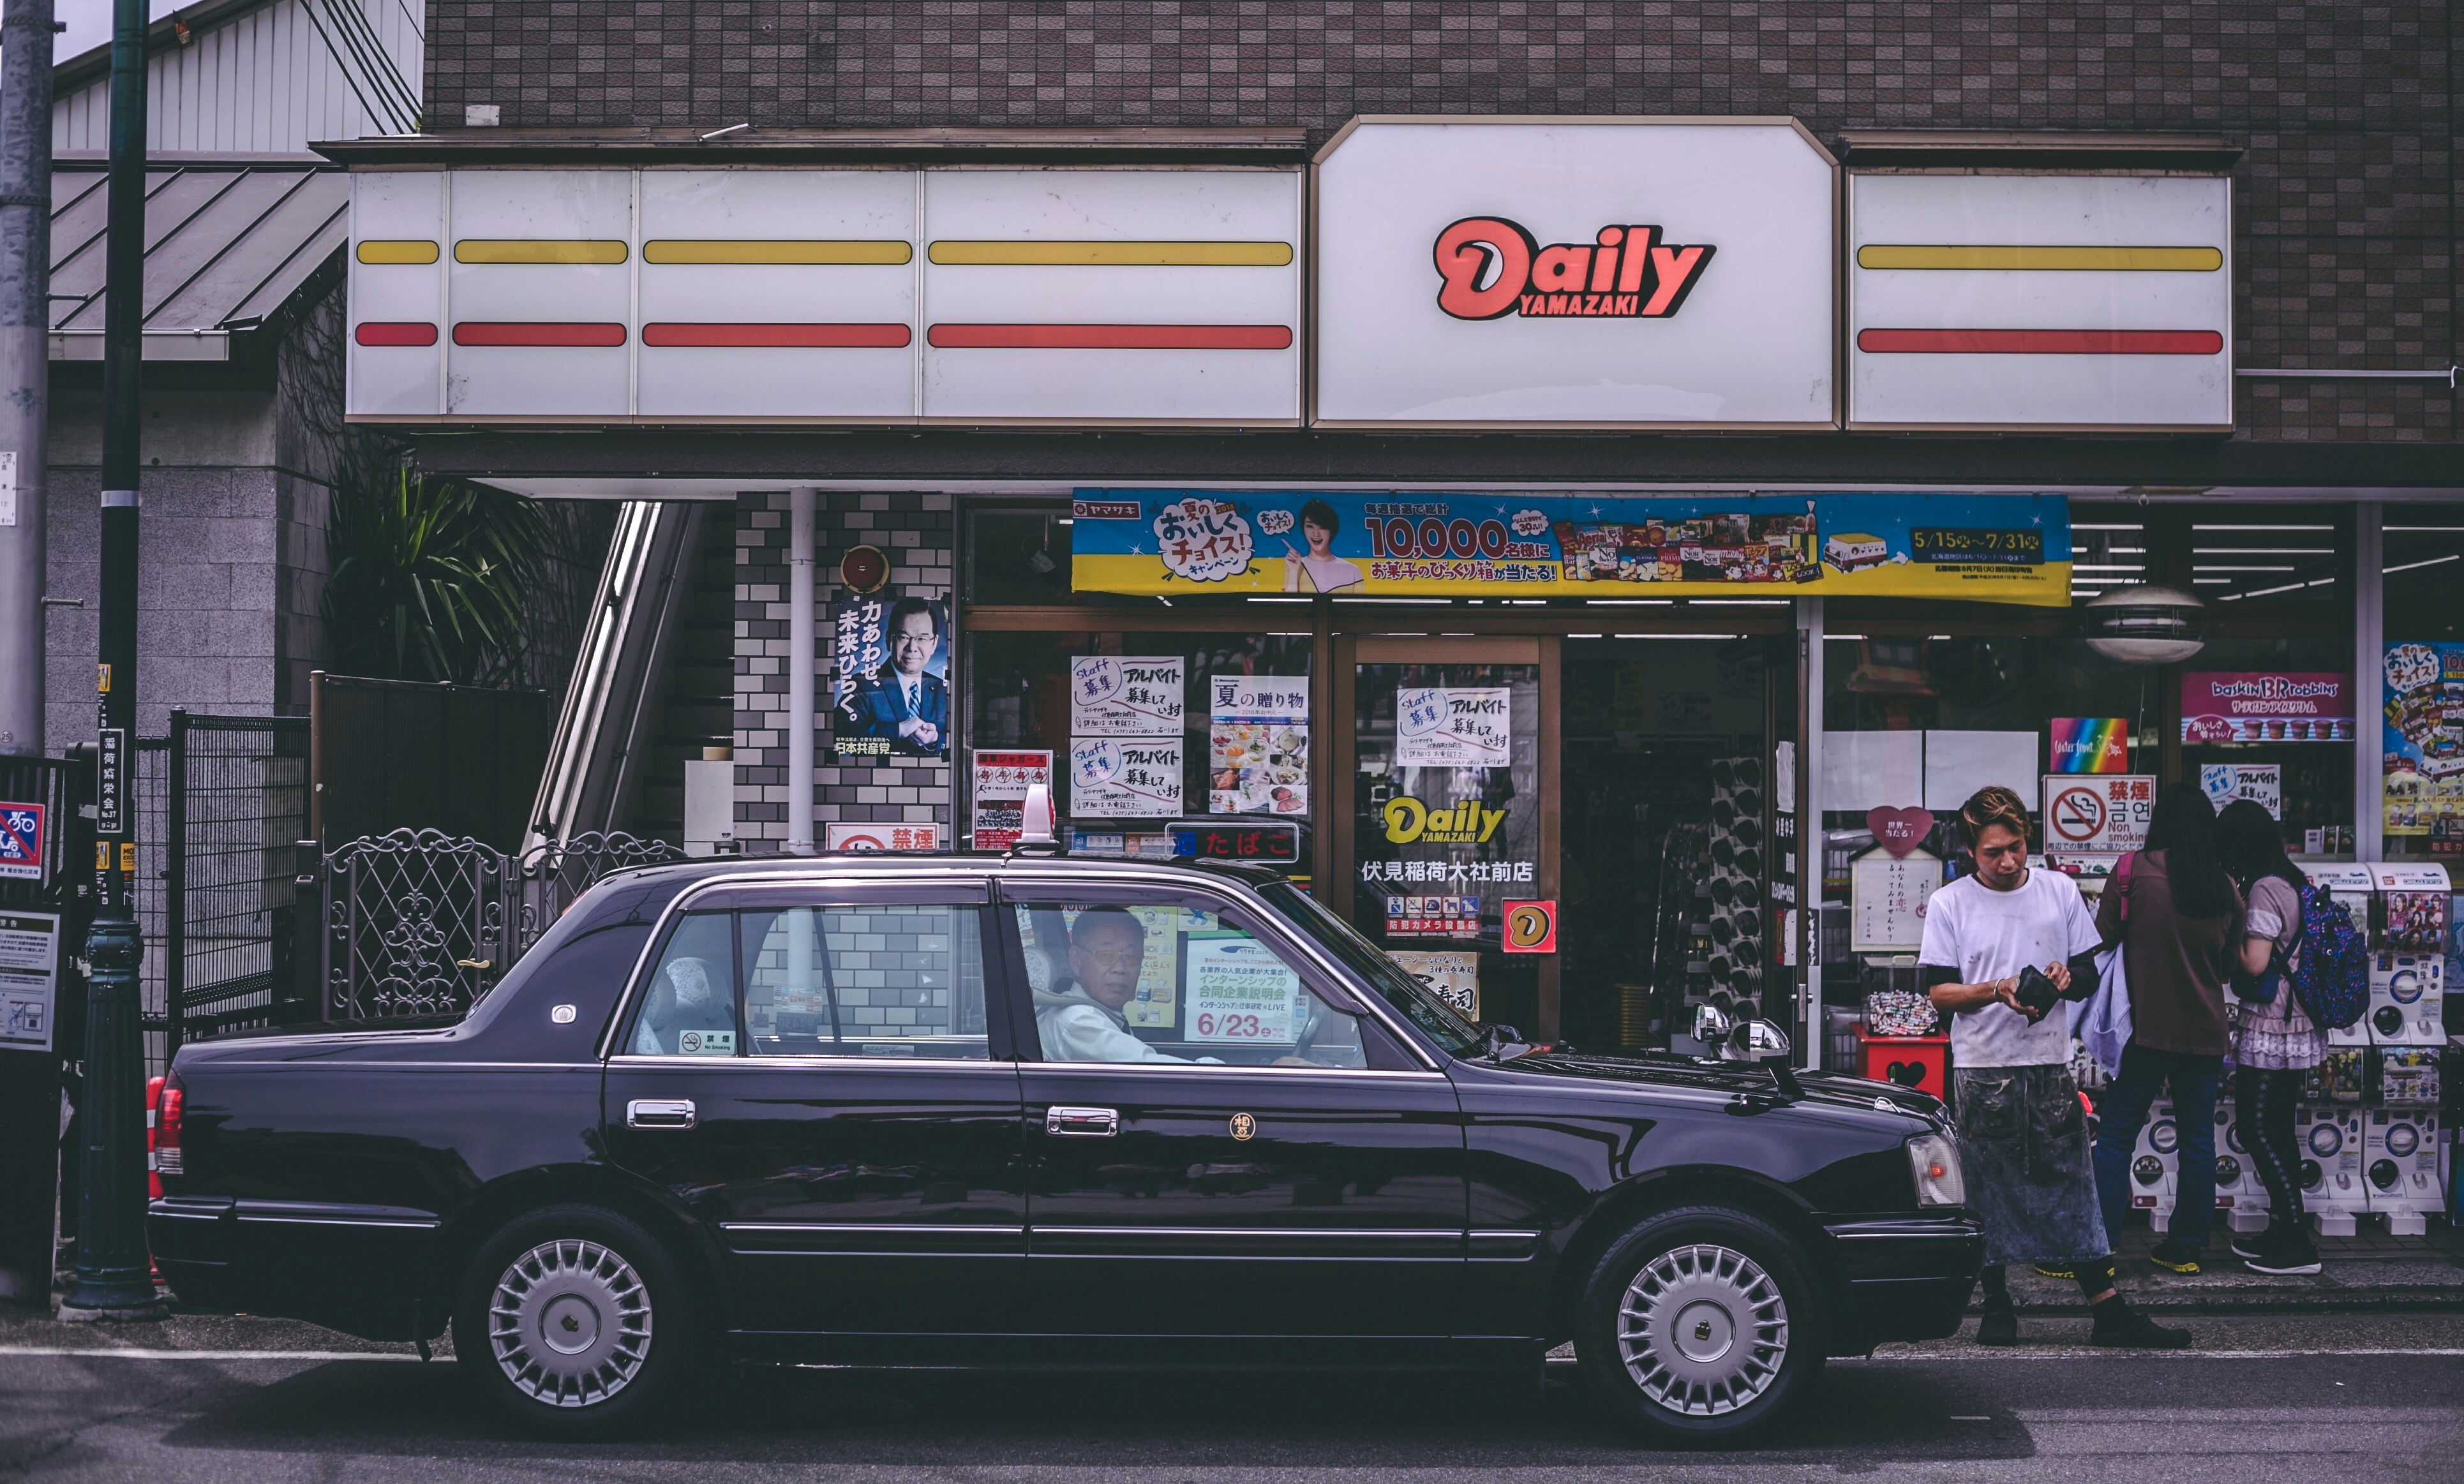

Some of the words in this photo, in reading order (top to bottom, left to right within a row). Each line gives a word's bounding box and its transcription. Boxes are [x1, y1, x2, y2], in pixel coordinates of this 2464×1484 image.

[1434, 216, 1717, 320] Daily
[1520, 295, 1638, 315] YAMAZAKI
[1090, 505, 1136, 514] ヤマサキ
[1182, 501, 1210, 522] 夏の
[1216, 504, 1234, 514] 2018
[1260, 512, 1288, 523] おいしく
[1365, 503, 1449, 516] 毎週抽選で総計
[1160, 513, 1238, 541] おいしく
[1264, 519, 1291, 532] チョイス!
[1365, 517, 1508, 559] 10,000
[1505, 544, 1550, 559] 名様に
[1172, 533, 1246, 565] チョイス!
[1188, 556, 1239, 575] キャンペーン
[1371, 561, 1557, 581] お菓子のびっくり箱が当たる!
[861, 601, 882, 687] 力あわせ、
[837, 609, 859, 722] 未来ひらく。
[1077, 658, 1109, 679] Staff
[2387, 652, 2432, 670] おいしく
[1123, 667, 1182, 684] アルバイト
[2393, 664, 2436, 685] チョイス!
[1084, 675, 1114, 698] 募集
[1125, 686, 1166, 704] 募集して
[1215, 683, 1304, 708] 夏の贈り物
[2213, 682, 2260, 697] baskin
[2260, 677, 2290, 699] BR
[2289, 682, 2338, 697] robbins
[1402, 689, 1435, 710] Staff
[1449, 699, 1507, 714] アルバイト
[1158, 702, 1182, 717] います
[1409, 706, 1440, 729] 募集
[1451, 718, 1492, 736] 募集して
[835, 741, 890, 755] 日本共産党
[1075, 739, 1108, 761] Staff
[1484, 734, 1508, 748] います
[1122, 750, 1180, 766] アルバイト
[1082, 757, 1113, 780] 募集
[1124, 768, 1165, 786] 募集して
[2237, 772, 2278, 784] アルバイト
[1157, 784, 1181, 799] います
[2109, 781, 2150, 801] 禁煙
[1384, 796, 1506, 843] Daily
[2109, 802, 2150, 822] 금연
[1888, 821, 1912, 829] 世界一
[2108, 822, 2130, 832] Non
[892, 829, 934, 849] 禁煙
[1206, 831, 1290, 854] たばこ
[1422, 832, 1475, 842] YAMAZAKI
[1361, 861, 1533, 882] 伏見稲荷大社前店
[1389, 920, 1476, 930] 防犯カメラ設置店
[1200, 967, 1287, 976] 各業界の人気企業が大集合!
[1200, 974, 1287, 986] インターンシップの
[1199, 985, 1286, 1000] 合同企業説明会
[1198, 1013, 1259, 1037] 6/23
[1261, 1028, 1271, 1037] 土
[706, 1035, 730, 1043] 禁煙
